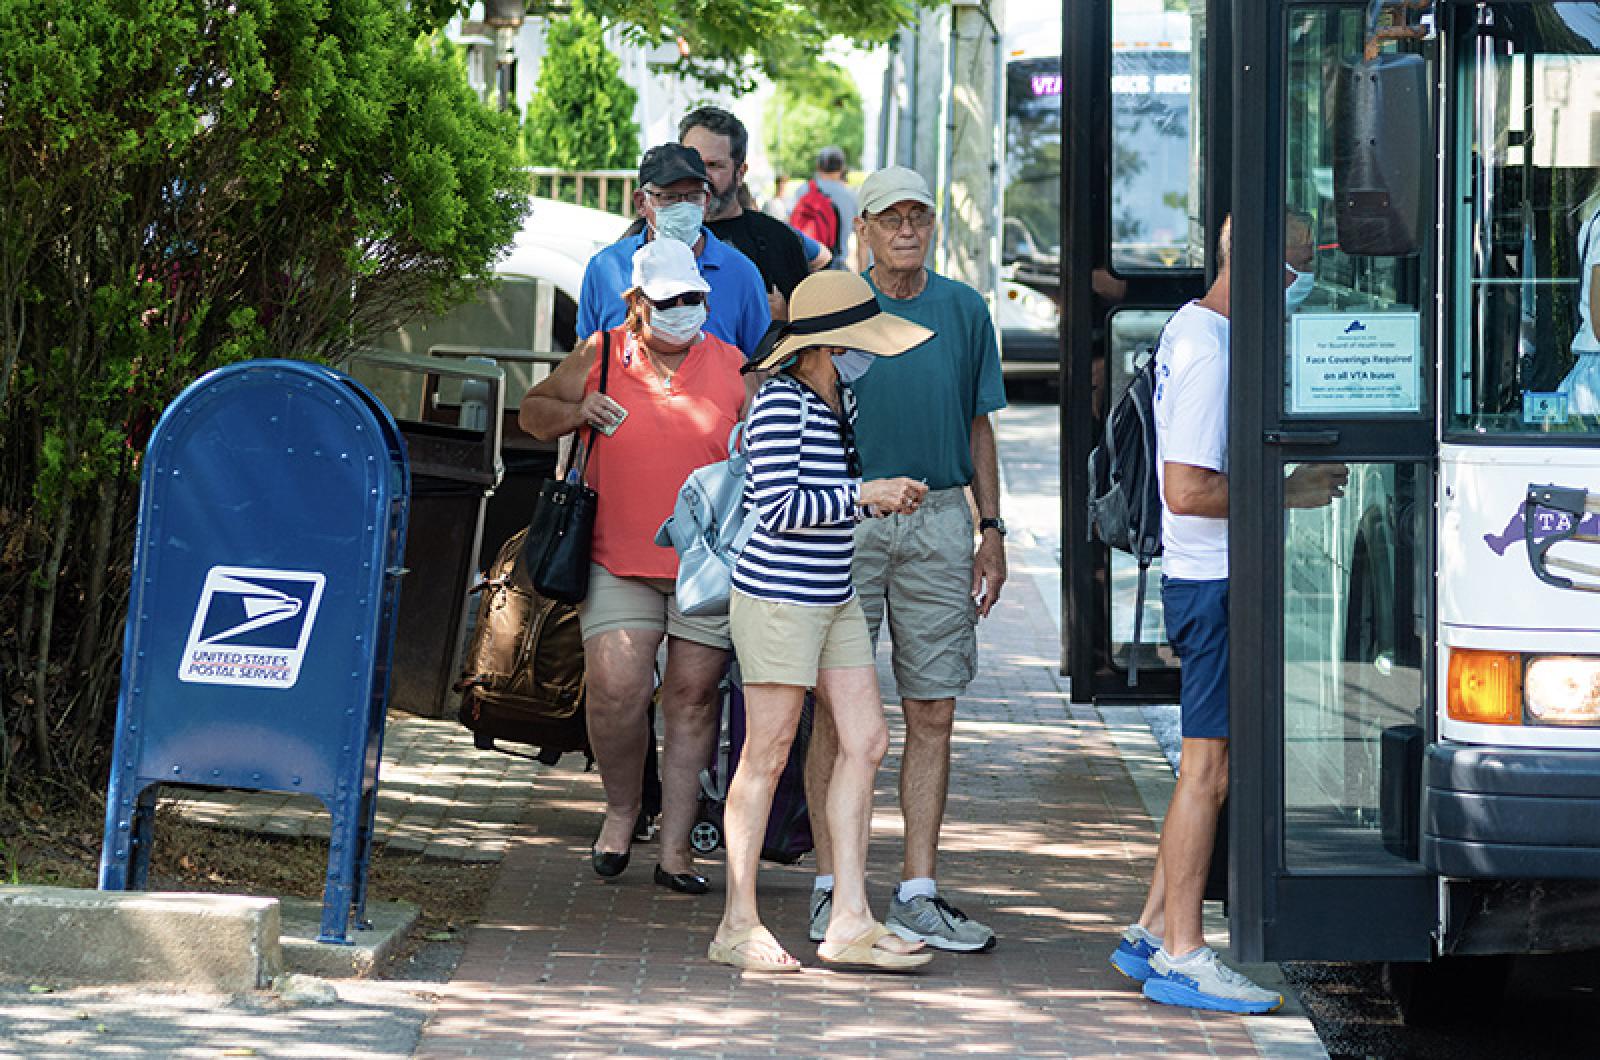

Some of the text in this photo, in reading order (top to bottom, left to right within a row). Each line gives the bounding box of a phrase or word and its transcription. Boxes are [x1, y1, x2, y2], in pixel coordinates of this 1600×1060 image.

[1305, 355, 1413, 365] Face Coverings Required
[1324, 371, 1395, 380] on all VTA buses
[192, 651, 289, 667] UNITED STATES
[188, 663, 291, 681] POSTAL SERVICE
